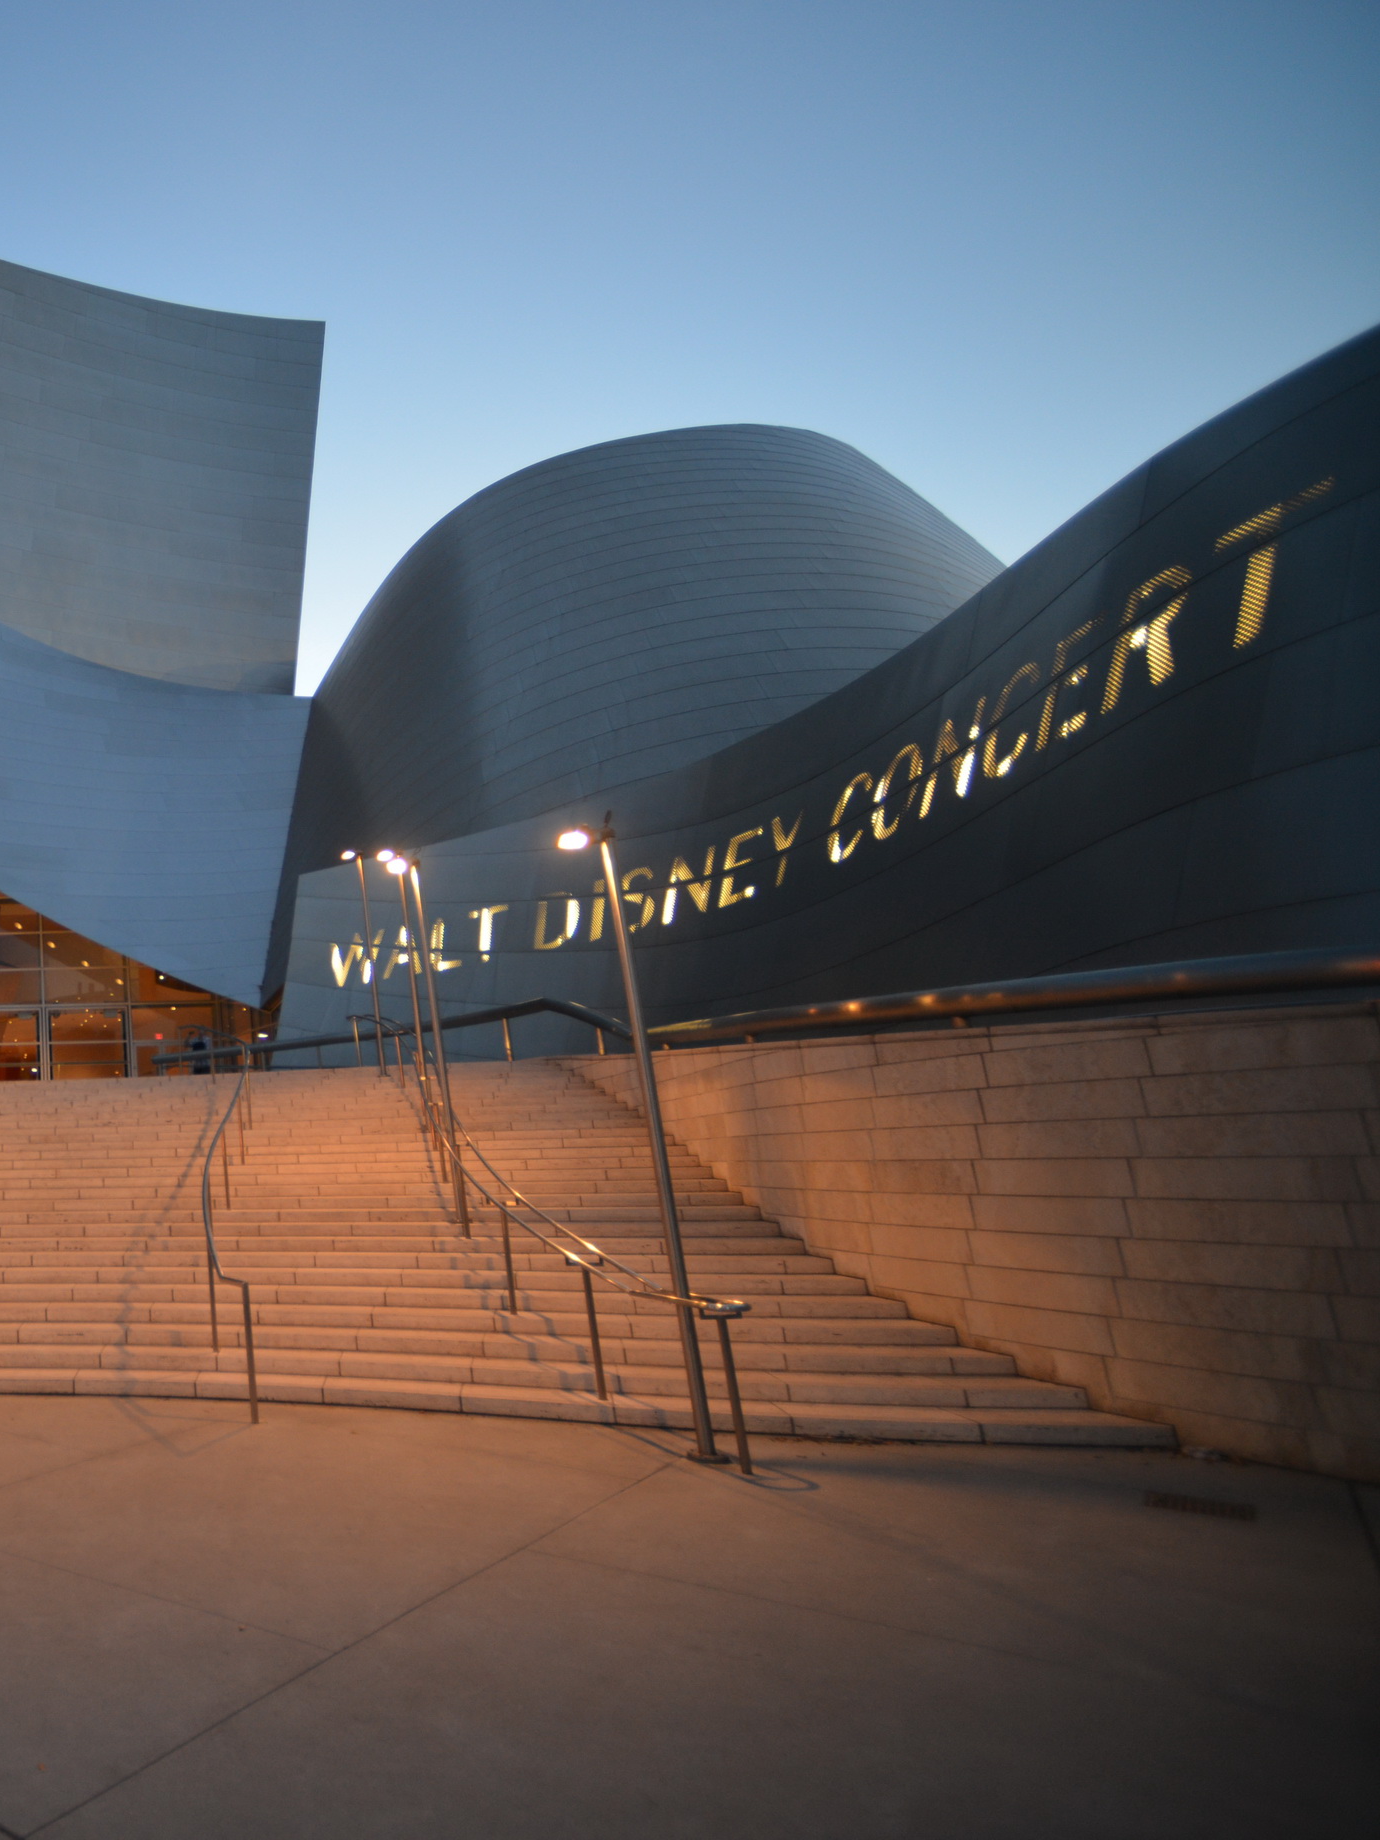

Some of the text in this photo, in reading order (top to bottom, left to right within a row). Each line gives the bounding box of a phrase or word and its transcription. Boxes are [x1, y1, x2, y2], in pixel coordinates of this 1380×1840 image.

[330, 476, 1336, 987] WALT DISNEY CONCERT
